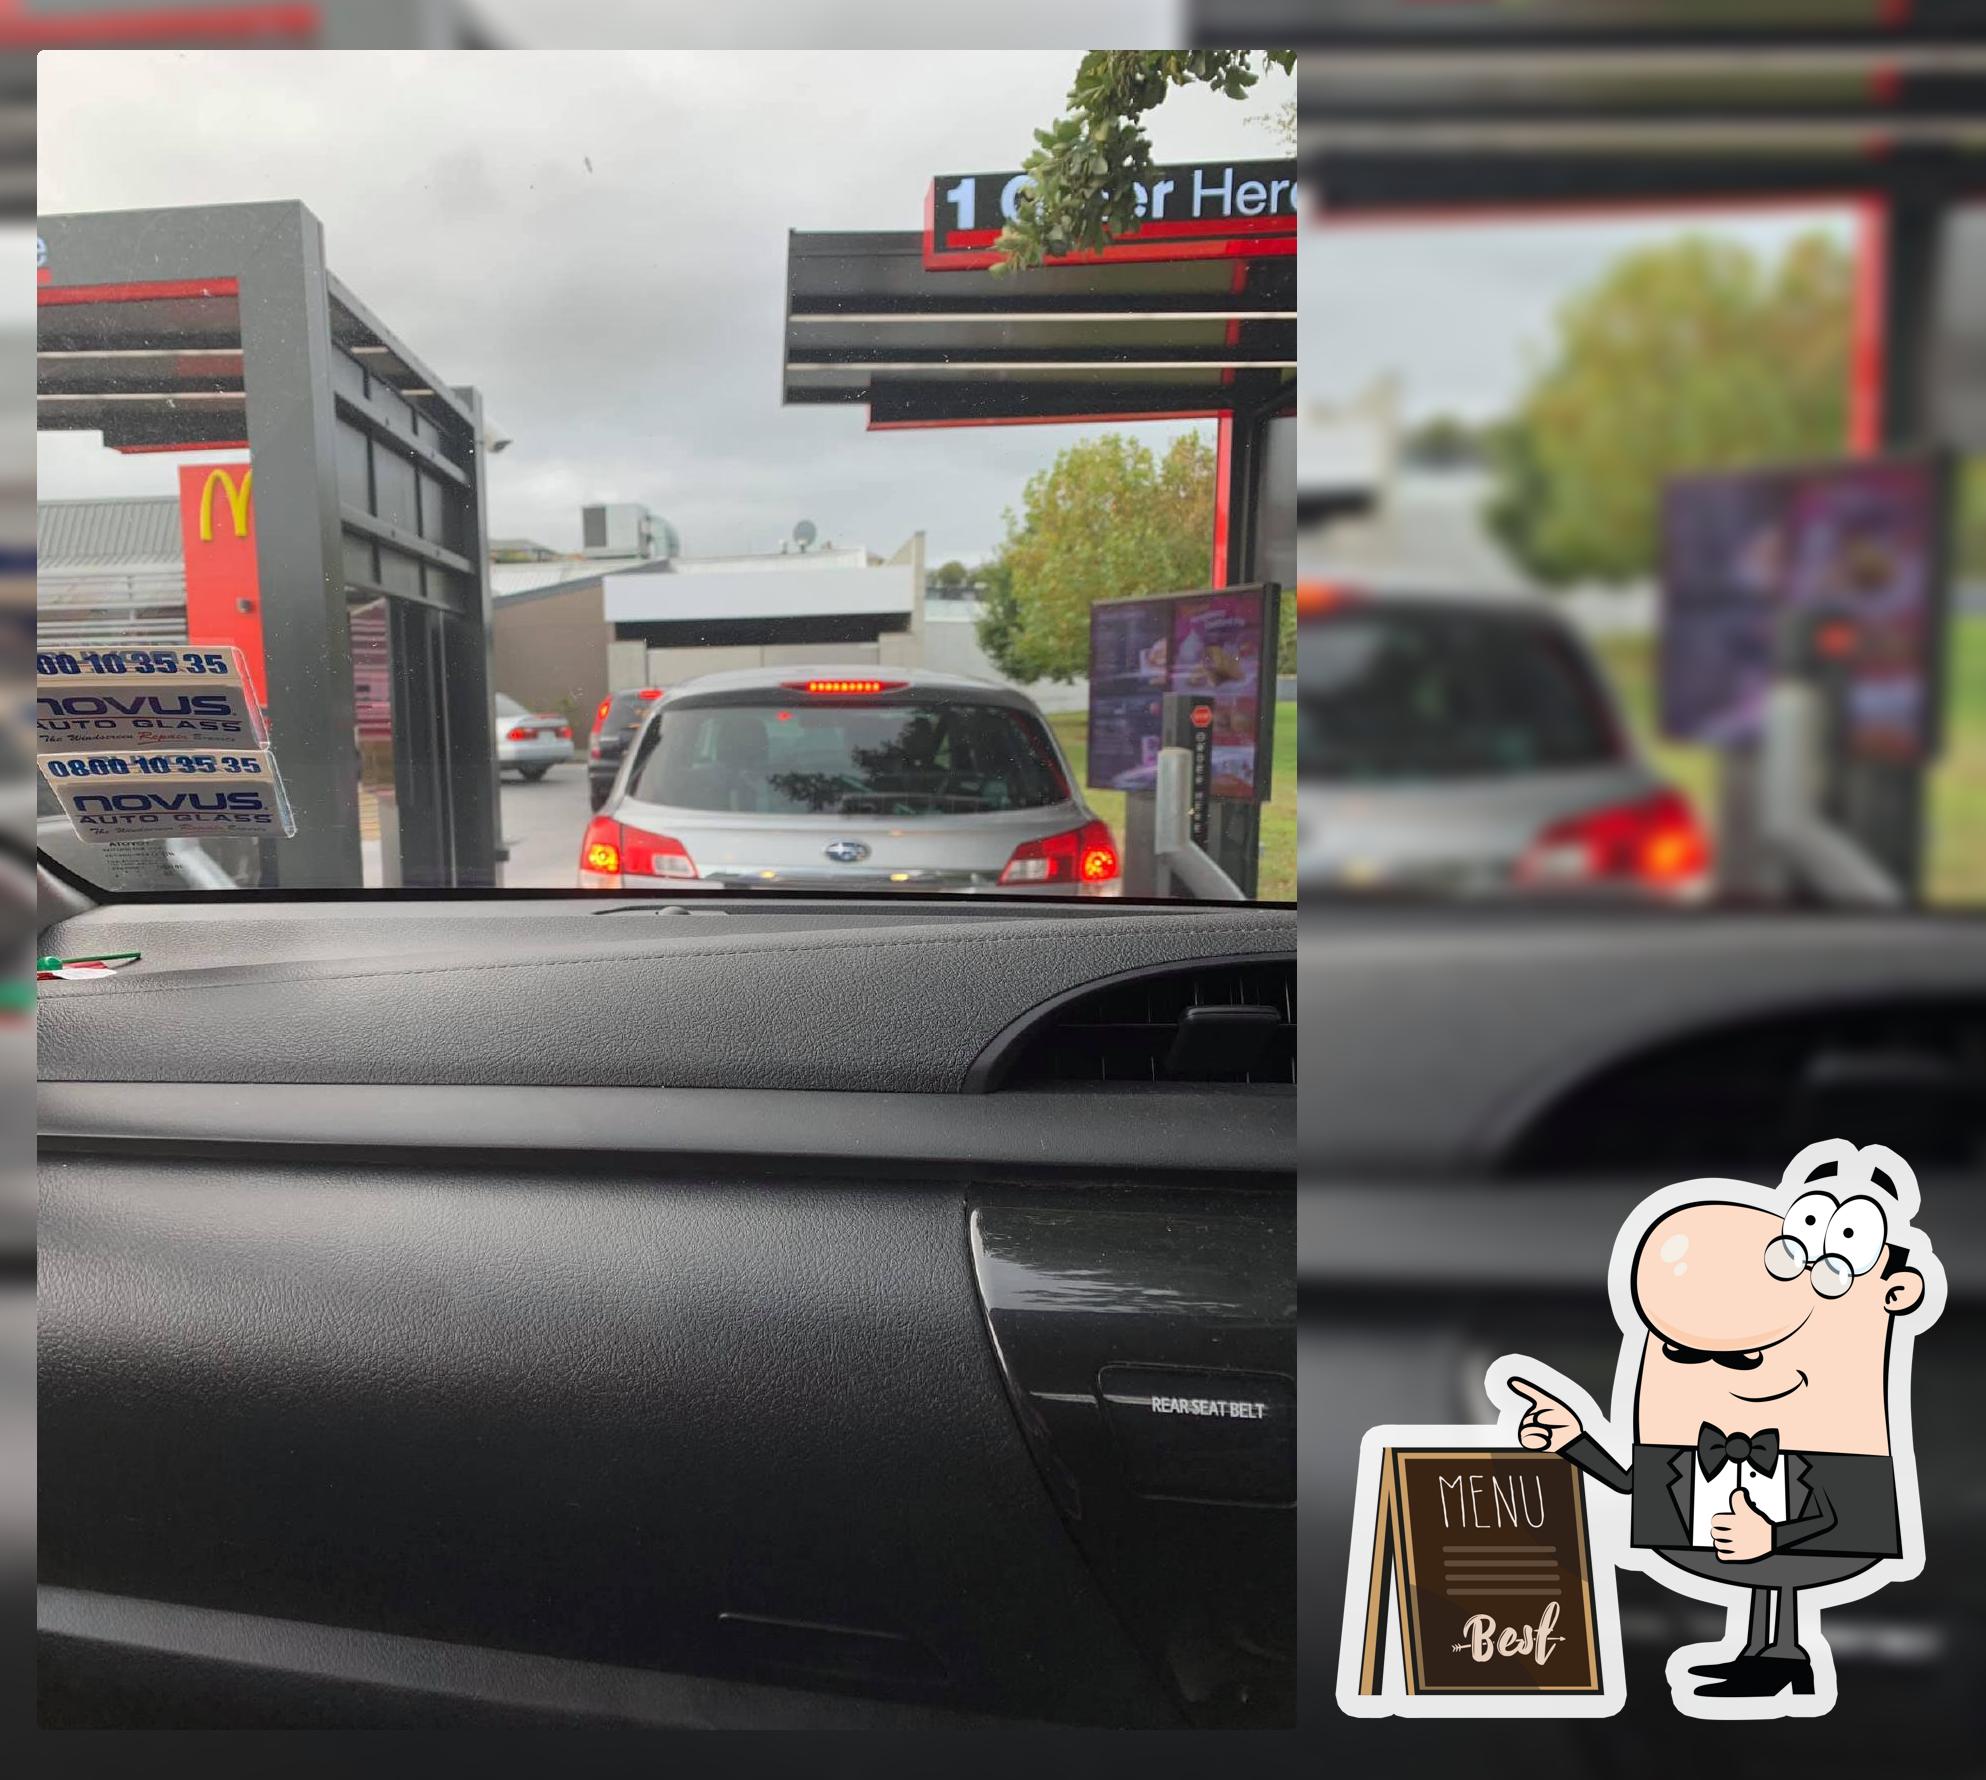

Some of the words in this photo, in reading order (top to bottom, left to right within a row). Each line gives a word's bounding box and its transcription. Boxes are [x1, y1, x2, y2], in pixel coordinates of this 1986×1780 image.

[946, 177, 976, 230] 1
[1192, 167, 1297, 218] Her
[84, 653, 127, 675] 10
[131, 653, 178, 675] 35
[183, 653, 228, 675] 35
[131, 719, 242, 732] GLASS
[47, 758, 130, 778] 0800
[133, 757, 171, 775] 10
[175, 756, 217, 774] 35
[221, 756, 262, 774] 35
[79, 814, 159, 825] AUTO
[173, 813, 272, 824] GLASS
[1151, 1396, 1190, 1414] REAR
[1191, 1398, 1227, 1417] SEAT
[1229, 1401, 1265, 1419] BELT
